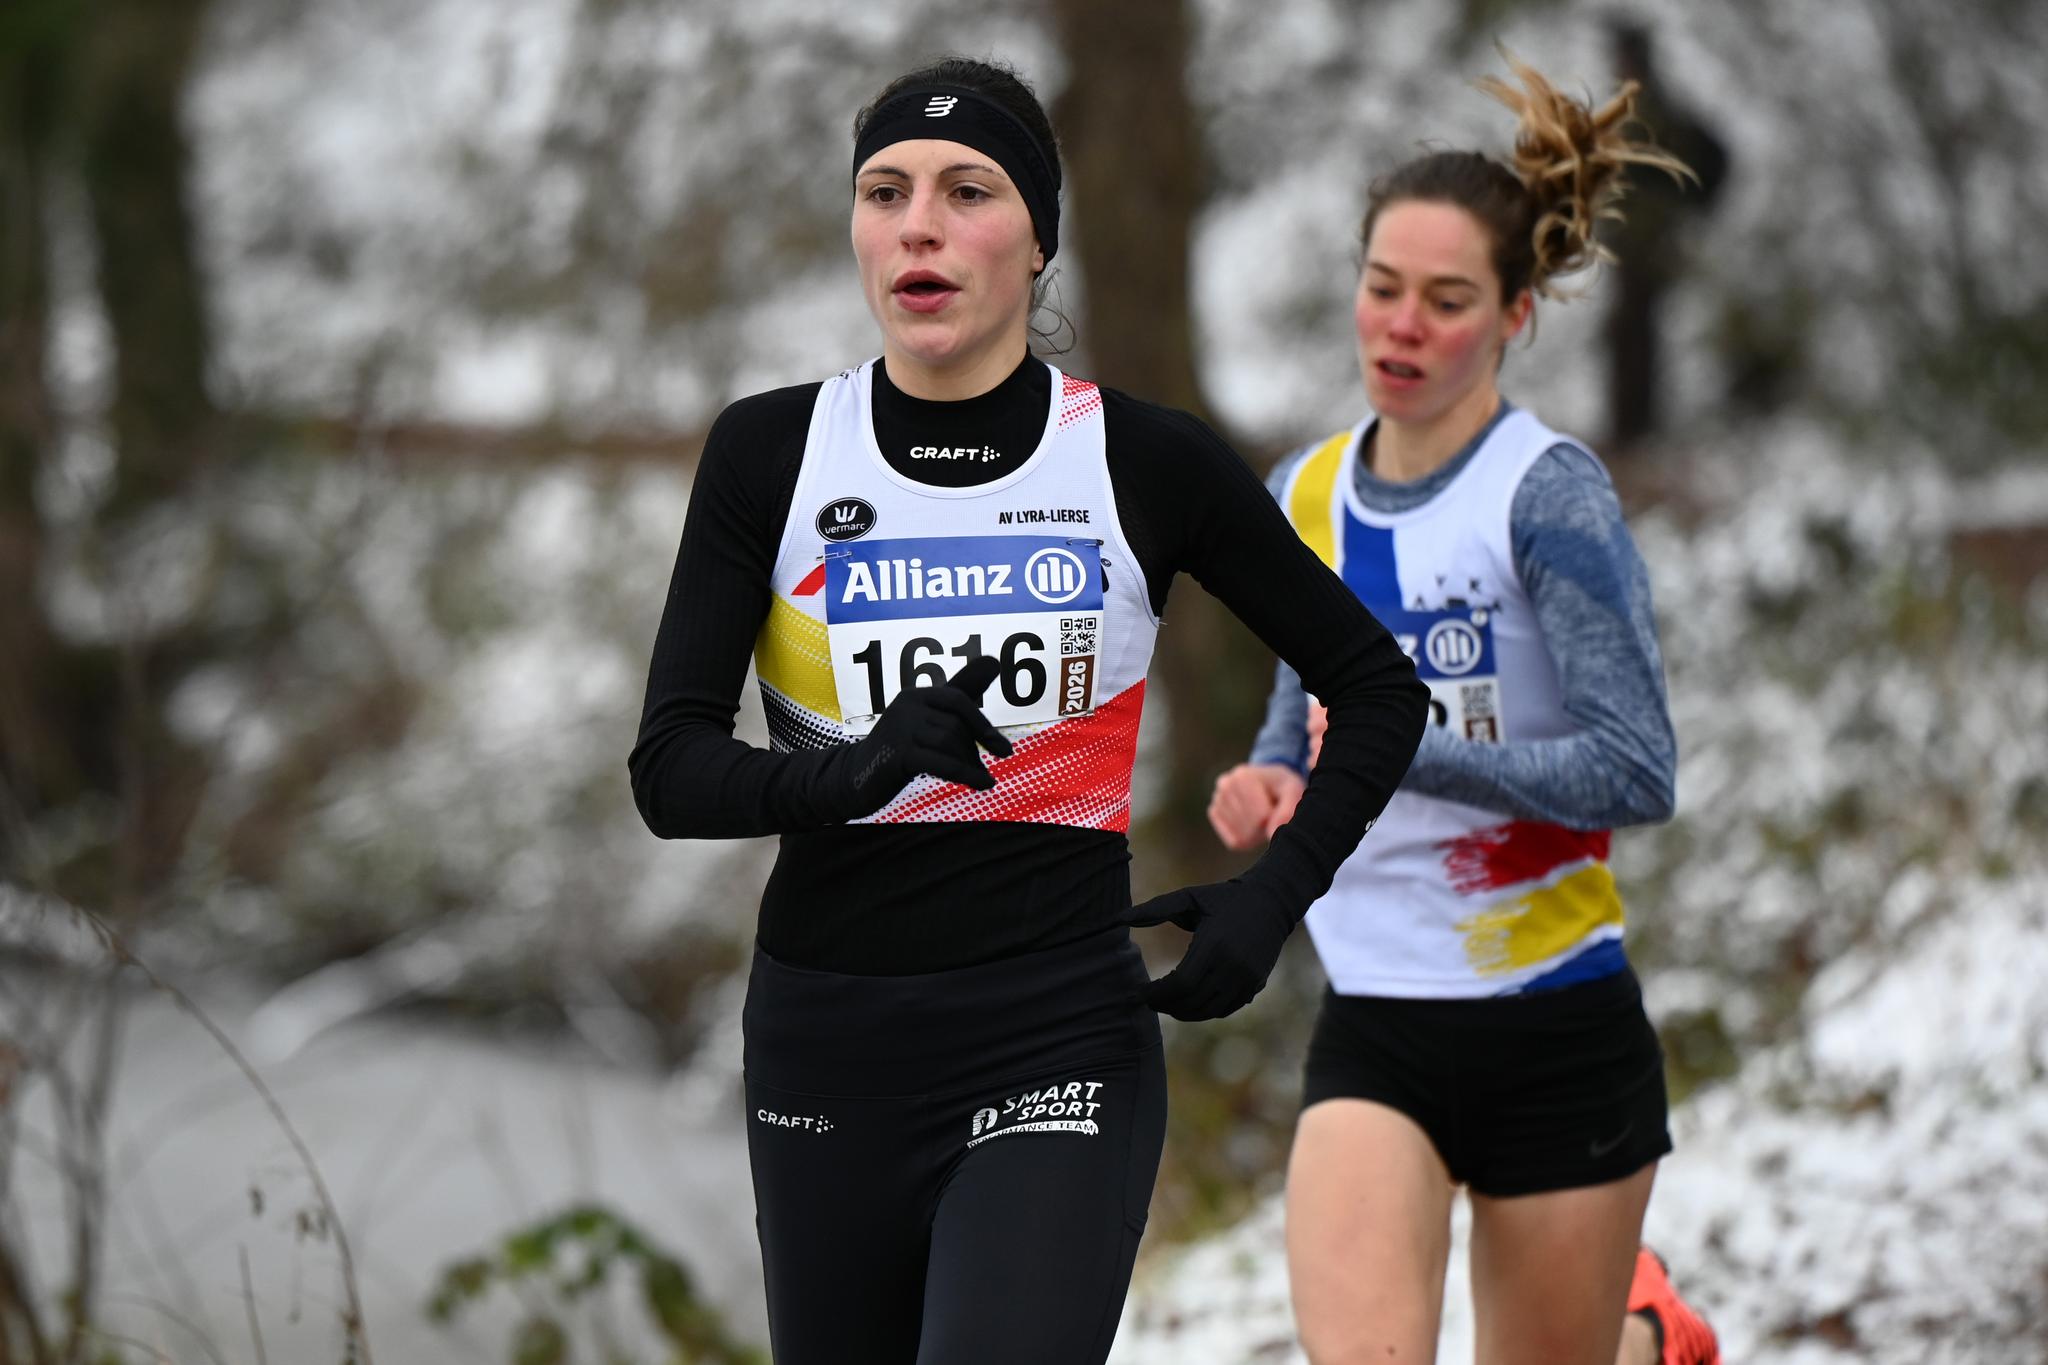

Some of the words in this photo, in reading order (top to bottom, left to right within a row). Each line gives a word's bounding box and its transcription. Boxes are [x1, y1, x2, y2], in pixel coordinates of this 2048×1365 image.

[909, 446, 979, 461] CRAFT
[999, 511, 1013, 525] AV
[1016, 509, 1090, 524] LYRA-LIERSE
[825, 523, 866, 534] vermarc
[841, 558, 1013, 604] Allianz
[1065, 661, 1087, 711] 2026
[1002, 1081, 1103, 1114] SMART
[757, 1109, 814, 1130] CRAFT
[1017, 1101, 1101, 1121] SPORT
[1058, 1121, 1095, 1133] TEAM
